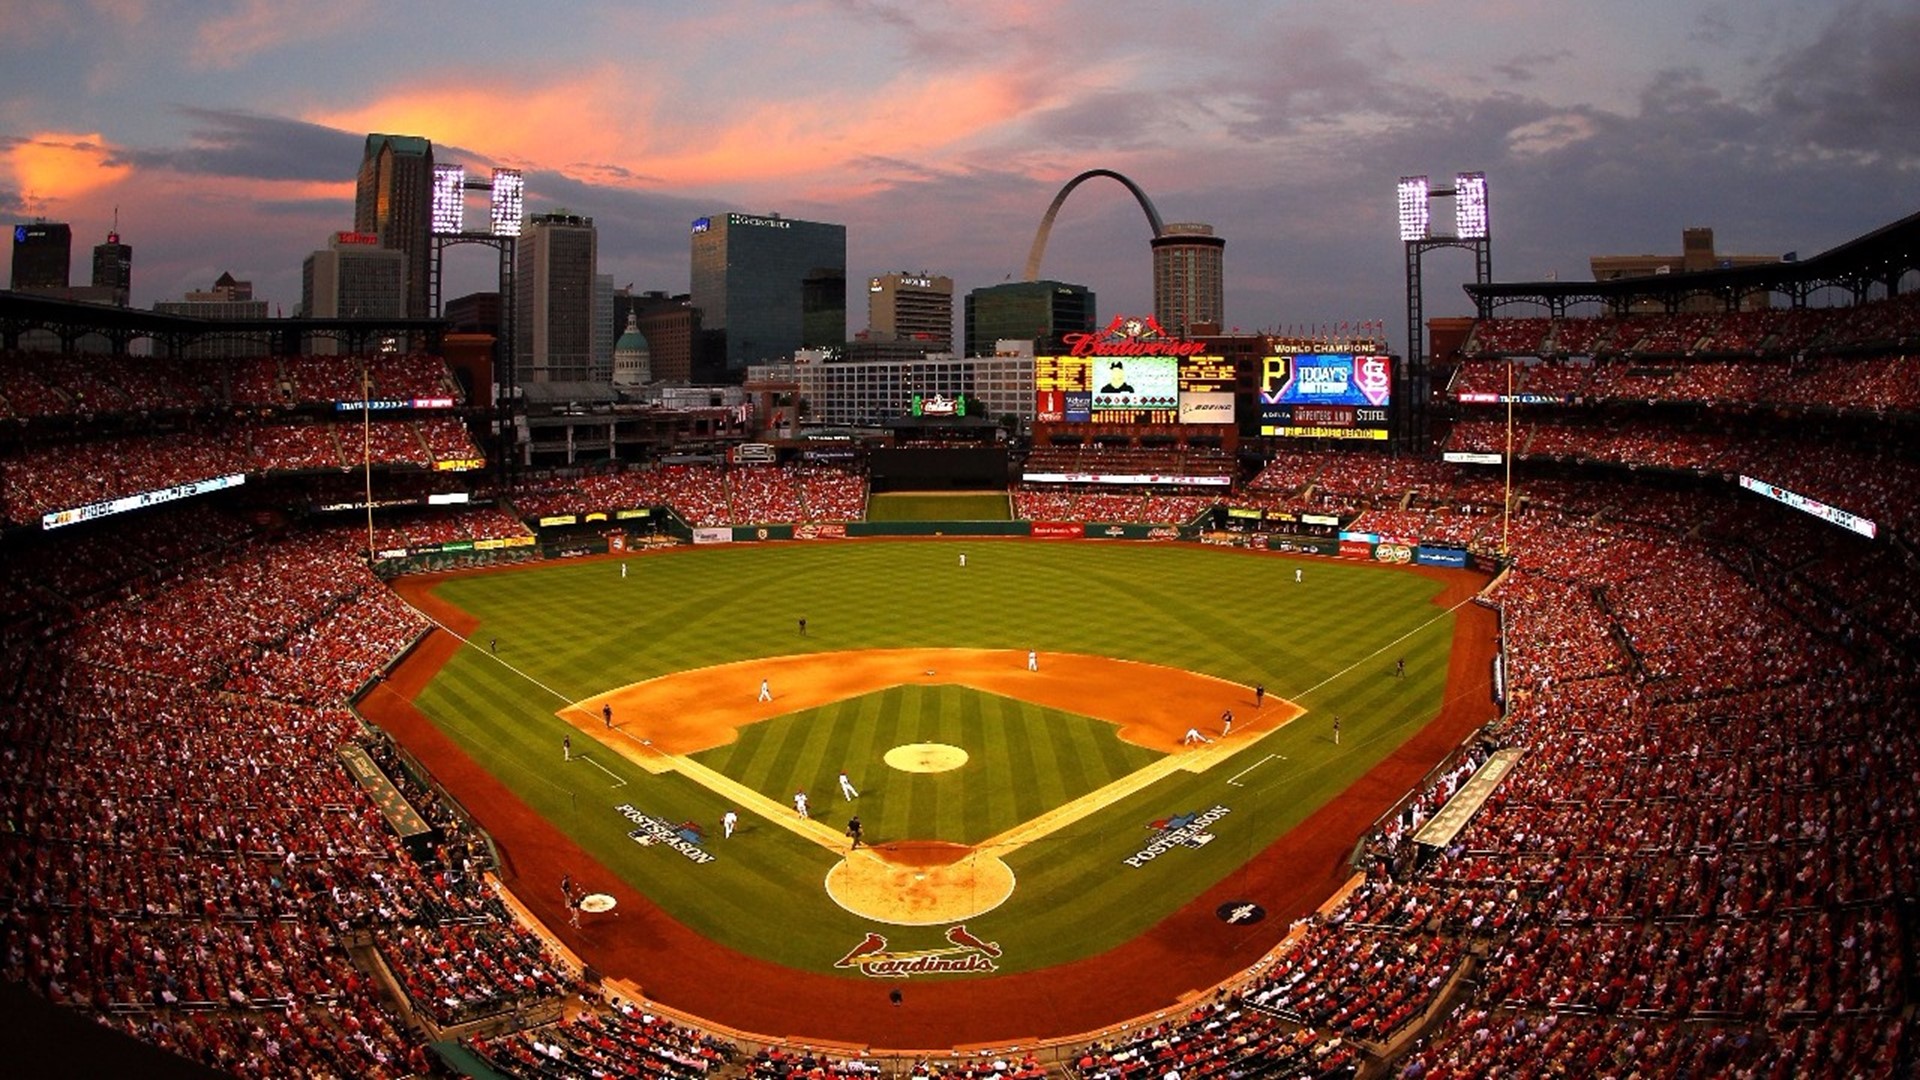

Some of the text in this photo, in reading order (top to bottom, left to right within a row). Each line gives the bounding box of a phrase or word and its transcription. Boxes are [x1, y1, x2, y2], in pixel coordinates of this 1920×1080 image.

[1062, 333, 1206, 356] Budweiser
[1274, 344, 1376, 353] WORLD CHAMPIONS
[1298, 367, 1348, 381] TODAY'S
[614, 804, 715, 864] POSTSEASON
[1123, 805, 1231, 868] POSTSEASON
[861, 953, 999, 978] Cardinals
